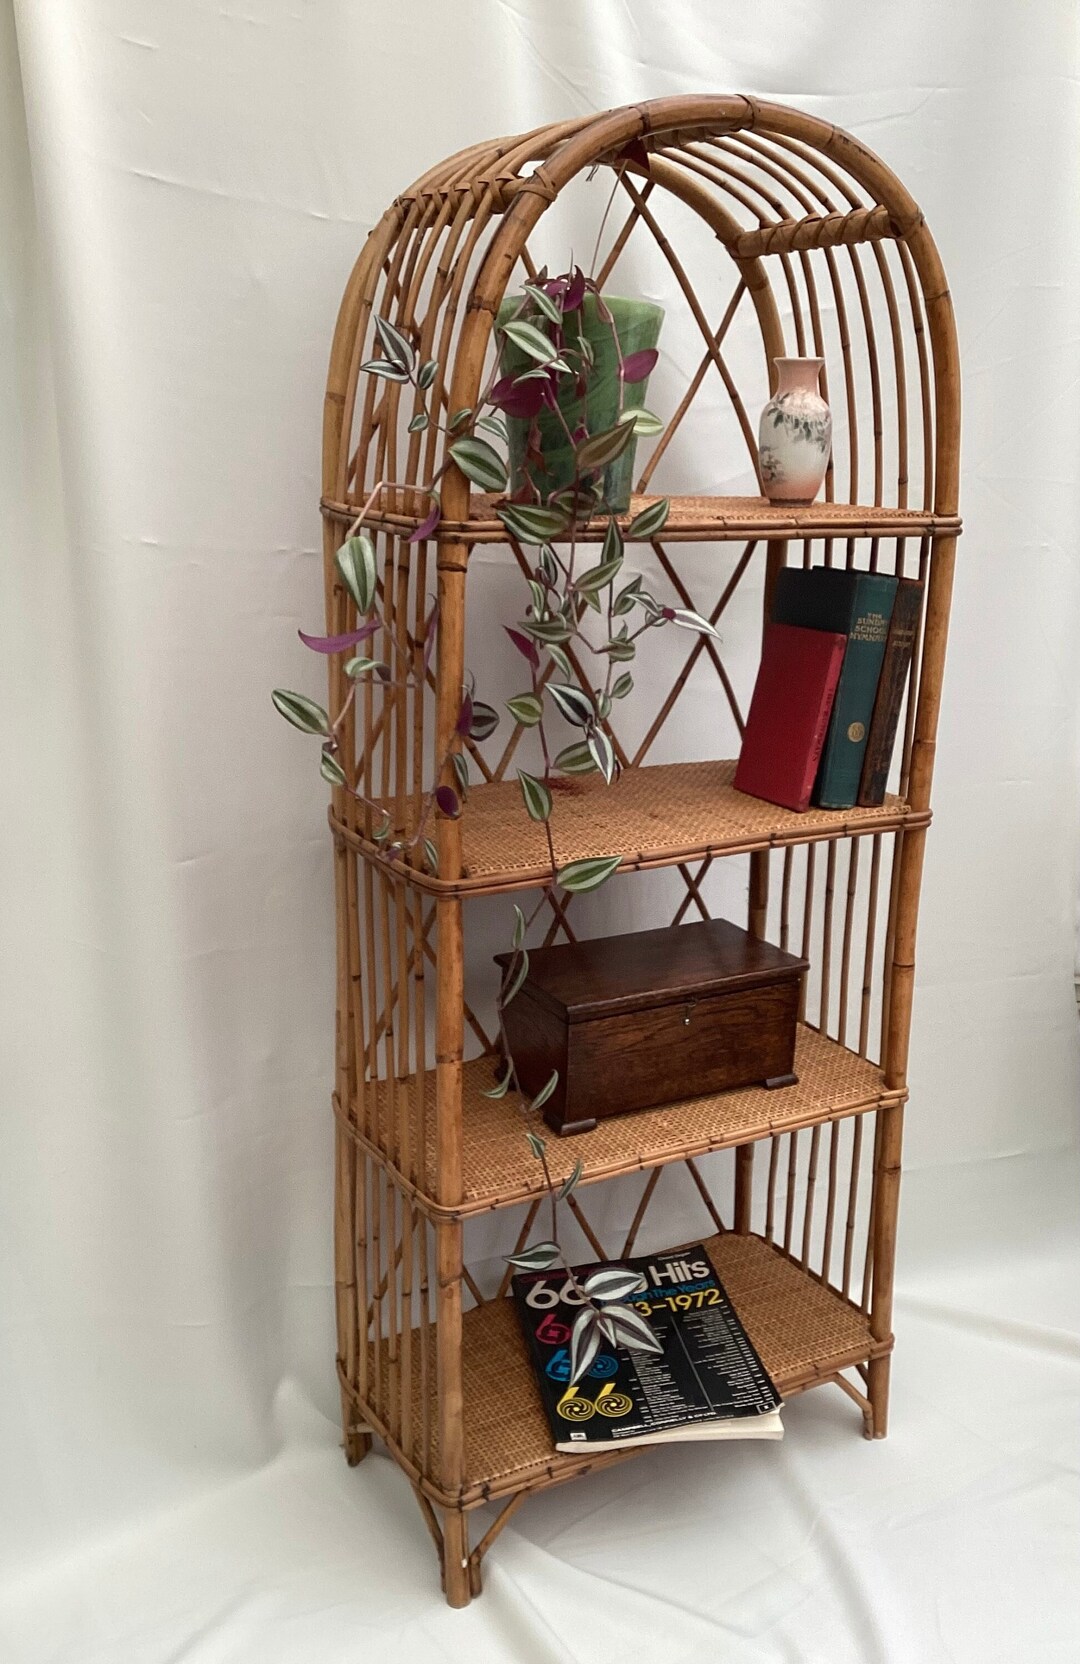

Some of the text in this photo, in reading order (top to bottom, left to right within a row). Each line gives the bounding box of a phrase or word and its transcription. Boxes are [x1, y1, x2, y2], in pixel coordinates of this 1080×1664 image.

[648, 1260, 711, 1286] Hits
[652, 1286, 677, 1300] The
[677, 1279, 716, 1294] Years
[556, 1382, 633, 1422] 66
